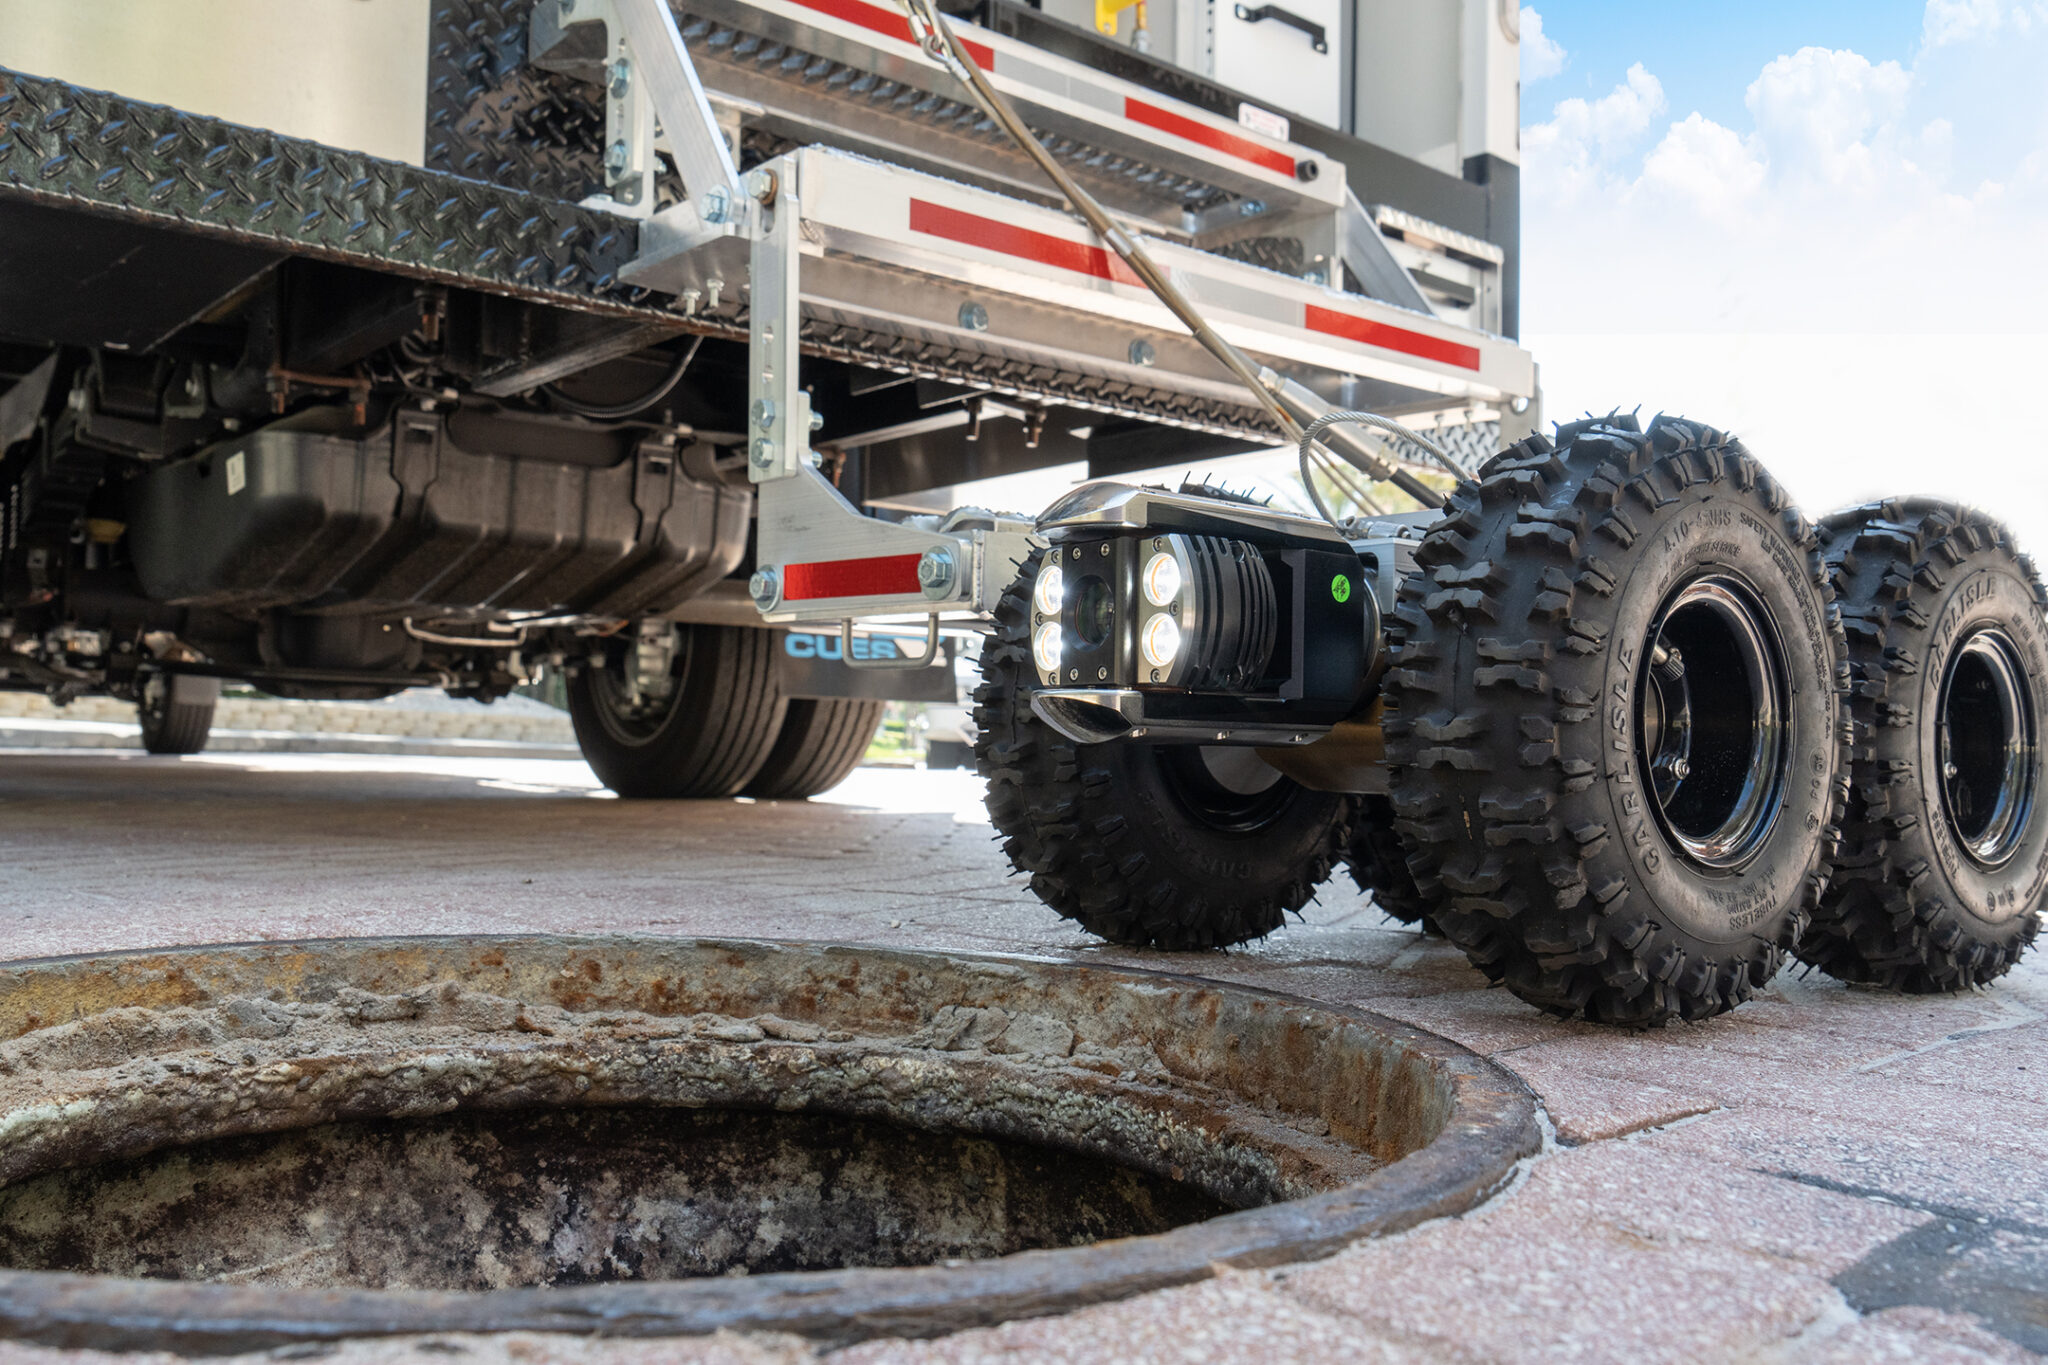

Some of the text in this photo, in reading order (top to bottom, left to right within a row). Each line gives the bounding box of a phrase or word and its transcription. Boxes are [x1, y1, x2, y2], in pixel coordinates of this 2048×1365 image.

[785, 633, 897, 660] CUES
[1930, 577, 1996, 690] CARLISLE
[1612, 638, 1659, 875] CARLISLE
